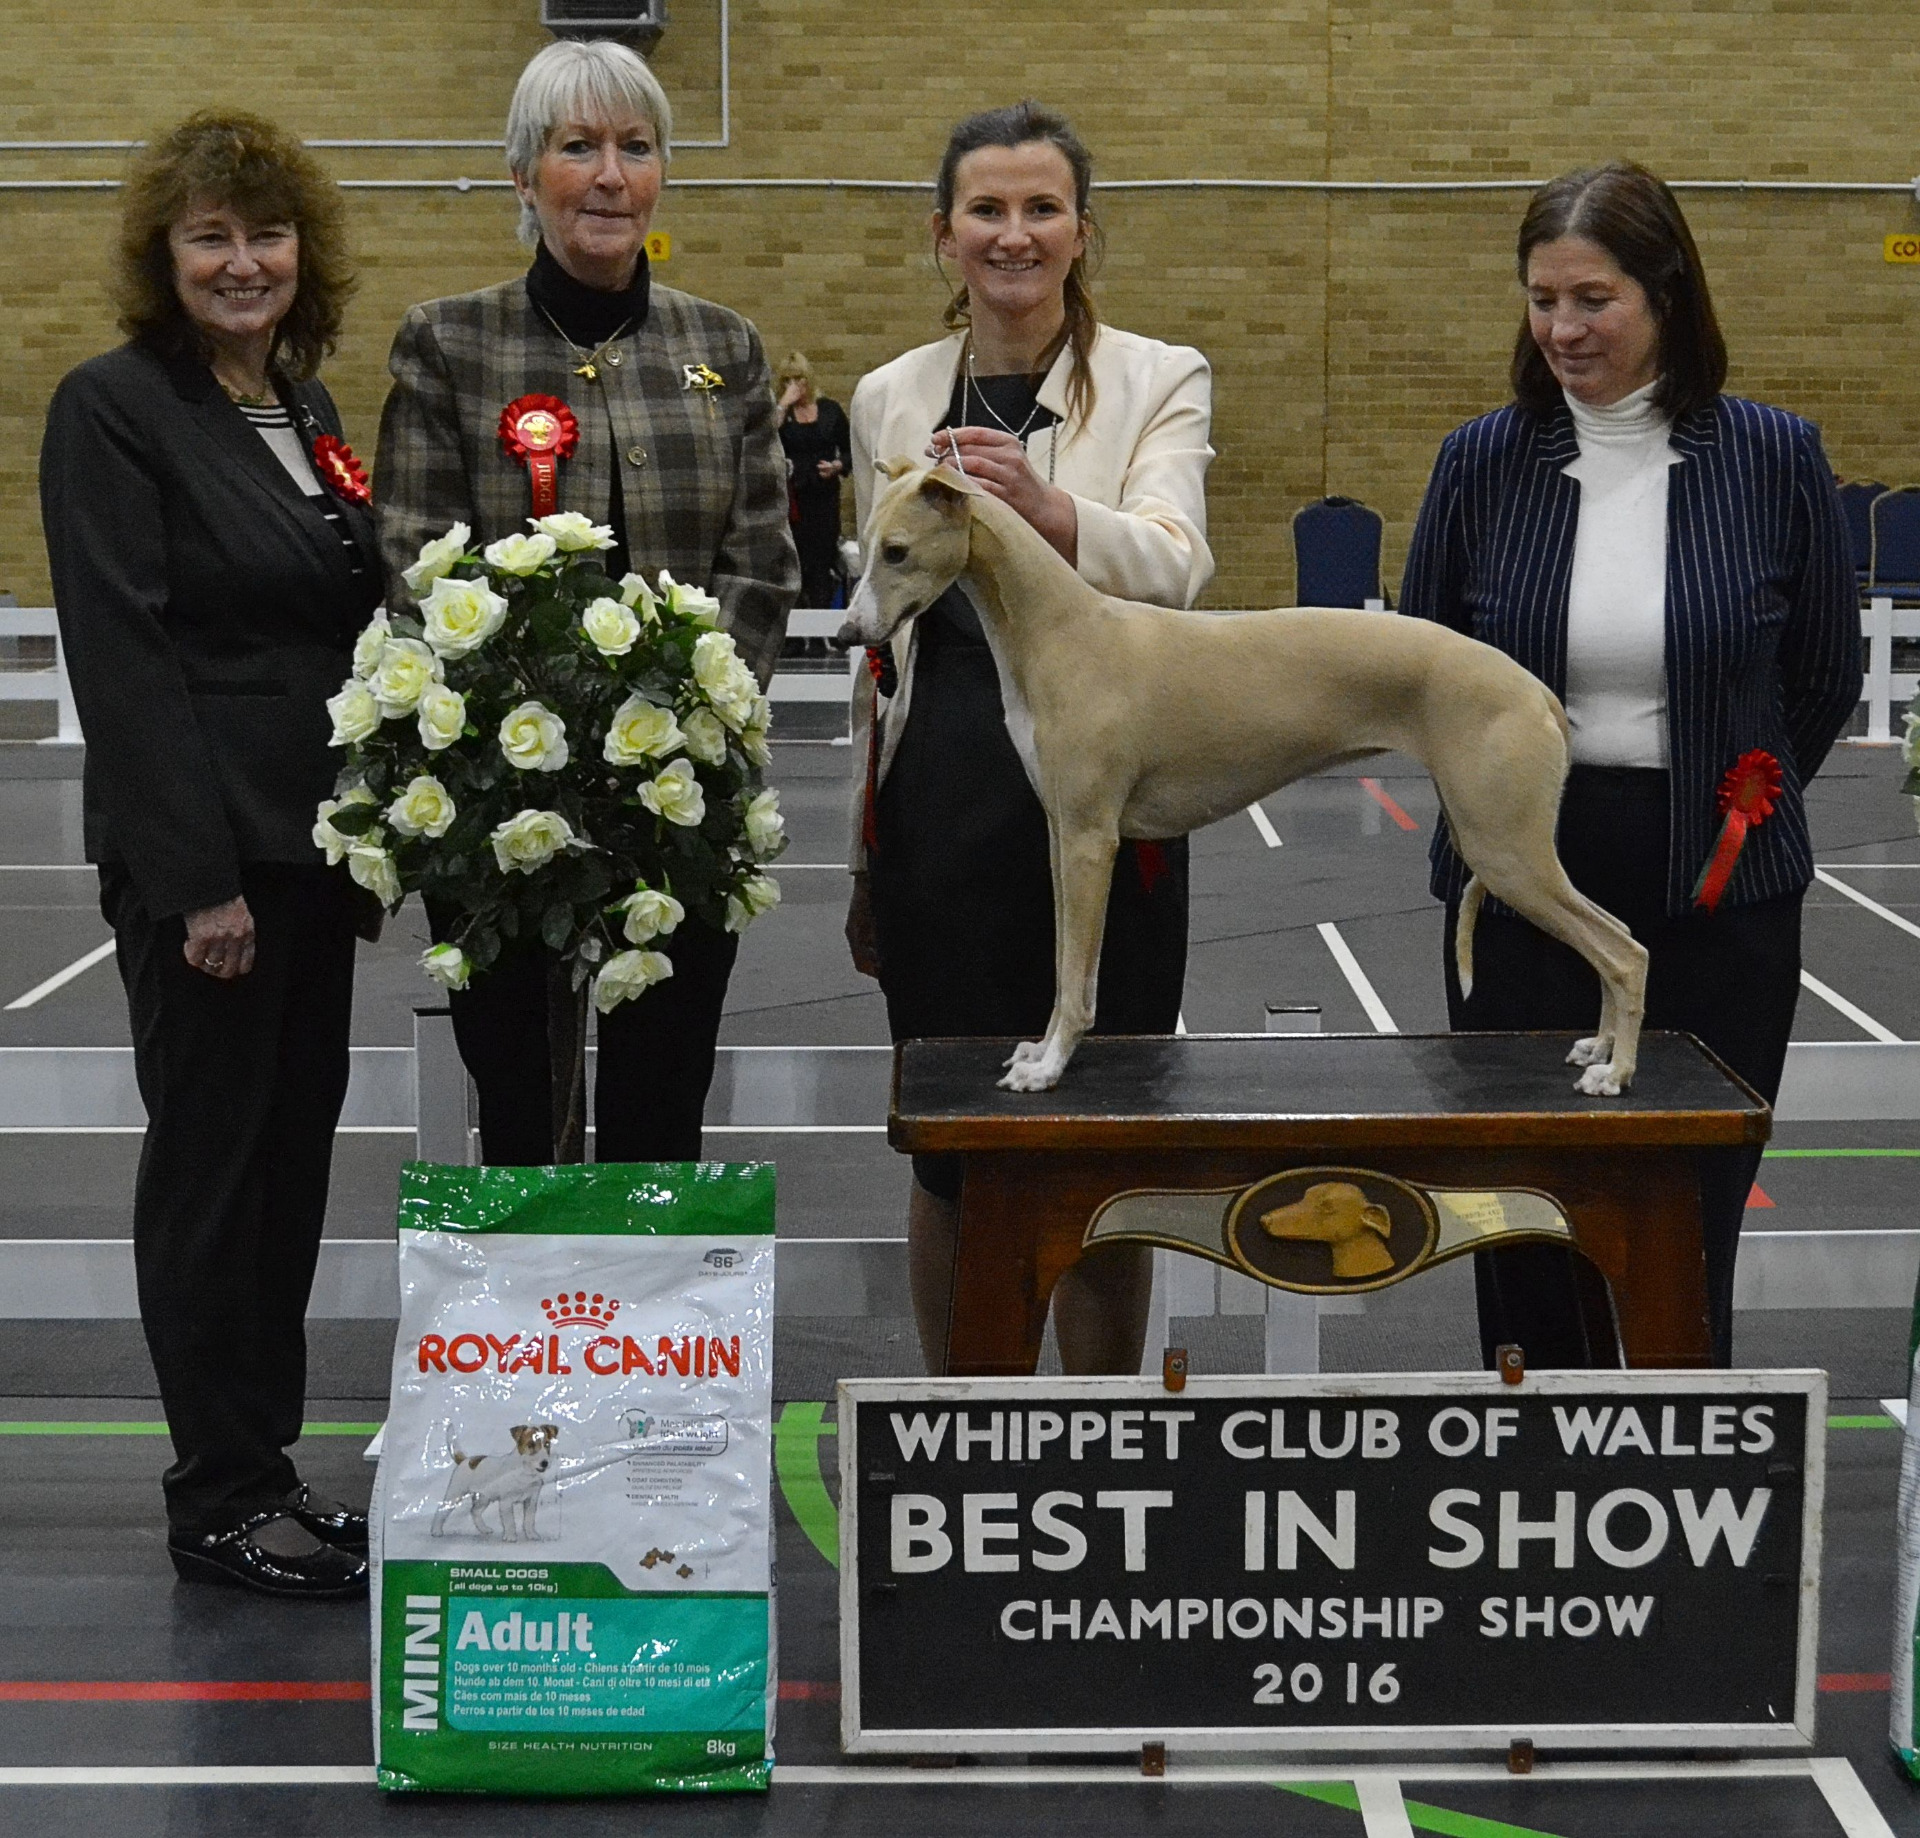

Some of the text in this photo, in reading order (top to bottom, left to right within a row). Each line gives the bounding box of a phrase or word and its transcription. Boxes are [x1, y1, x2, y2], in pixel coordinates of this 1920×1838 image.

[1892, 241, 1920, 257] CO
[713, 1256, 733, 1268] 86
[419, 1334, 739, 1377] ROYAL CANIN
[890, 1405, 1774, 1461] WHIPPET CLUB OF WALES
[890, 1488, 1771, 1573] BEST IN SHOW
[450, 1568, 549, 1579] SMALL DOGS
[469, 1582, 493, 1592] dogs
[496, 1584, 508, 1592] up
[1000, 1595, 1653, 1641] CHAMPIONSHIP SHOW
[455, 1611, 593, 1651] Adult
[403, 1595, 441, 1730] MINI
[455, 1662, 480, 1674] Dogs
[483, 1664, 504, 1672] over
[507, 1663, 518, 1672] 10
[521, 1663, 557, 1672] months
[560, 1663, 576, 1672] old
[584, 1663, 618, 1673] Chiens
[630, 1663, 655, 1675] partir
[658, 1663, 670, 1673] de
[674, 1663, 684, 1673] 10
[687, 1663, 710, 1673] mois
[454, 1676, 485, 1686] Hunde
[489, 1676, 500, 1686] ab
[503, 1676, 524, 1686] dem
[544, 1677, 573, 1687] Monat
[582, 1677, 604, 1687] Cani
[607, 1677, 616, 1687] di
[618, 1677, 640, 1687] oltre
[644, 1677, 655, 1687] 10
[658, 1677, 680, 1687] mesi
[683, 1677, 692, 1687] di
[481, 1692, 501, 1700] com
[504, 1690, 527, 1700] mais
[530, 1691, 542, 1700] de
[545, 1691, 556, 1700] 10
[559, 1693, 591, 1701] meses
[453, 1704, 644, 1717] Perros a partir de los 10 meses de edad
[489, 1741, 652, 1750] SIZE HEALTH NUTRITION
[706, 1740, 735, 1756] 8kg
